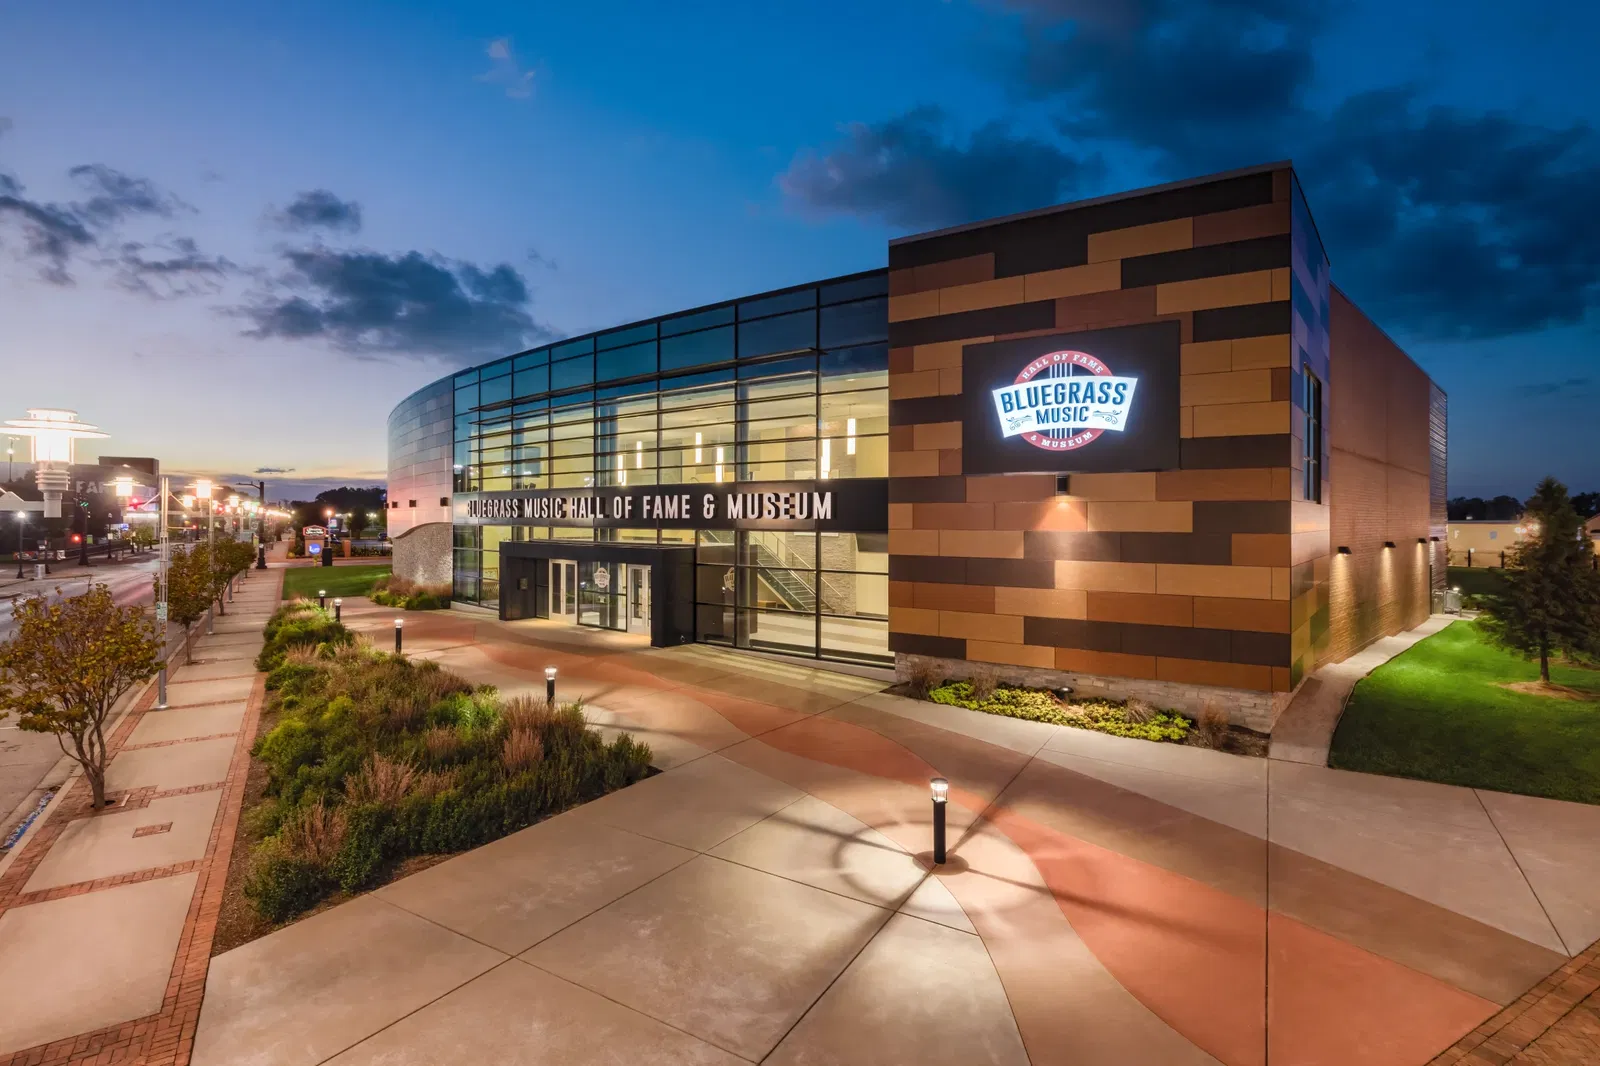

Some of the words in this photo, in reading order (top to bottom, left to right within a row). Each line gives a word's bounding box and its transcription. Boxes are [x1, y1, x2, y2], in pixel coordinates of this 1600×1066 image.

[1022, 359, 1049, 380] HALL
[1053, 353, 1069, 362] OF
[1073, 354, 1104, 374] FAME
[1001, 381, 1128, 413] BLUEGRASS
[1036, 406, 1090, 425] MUSIC
[1030, 434, 1038, 442] &
[1041, 431, 1094, 448] MUSEUM
[467, 498, 518, 519] BLUEGRASS
[525, 497, 562, 519] MUSIC
[570, 496, 603, 519] HALL
[613, 496, 632, 519] OF
[643, 494, 691, 519] FAME
[703, 493, 715, 519] &
[728, 491, 832, 520] MUSEUM
